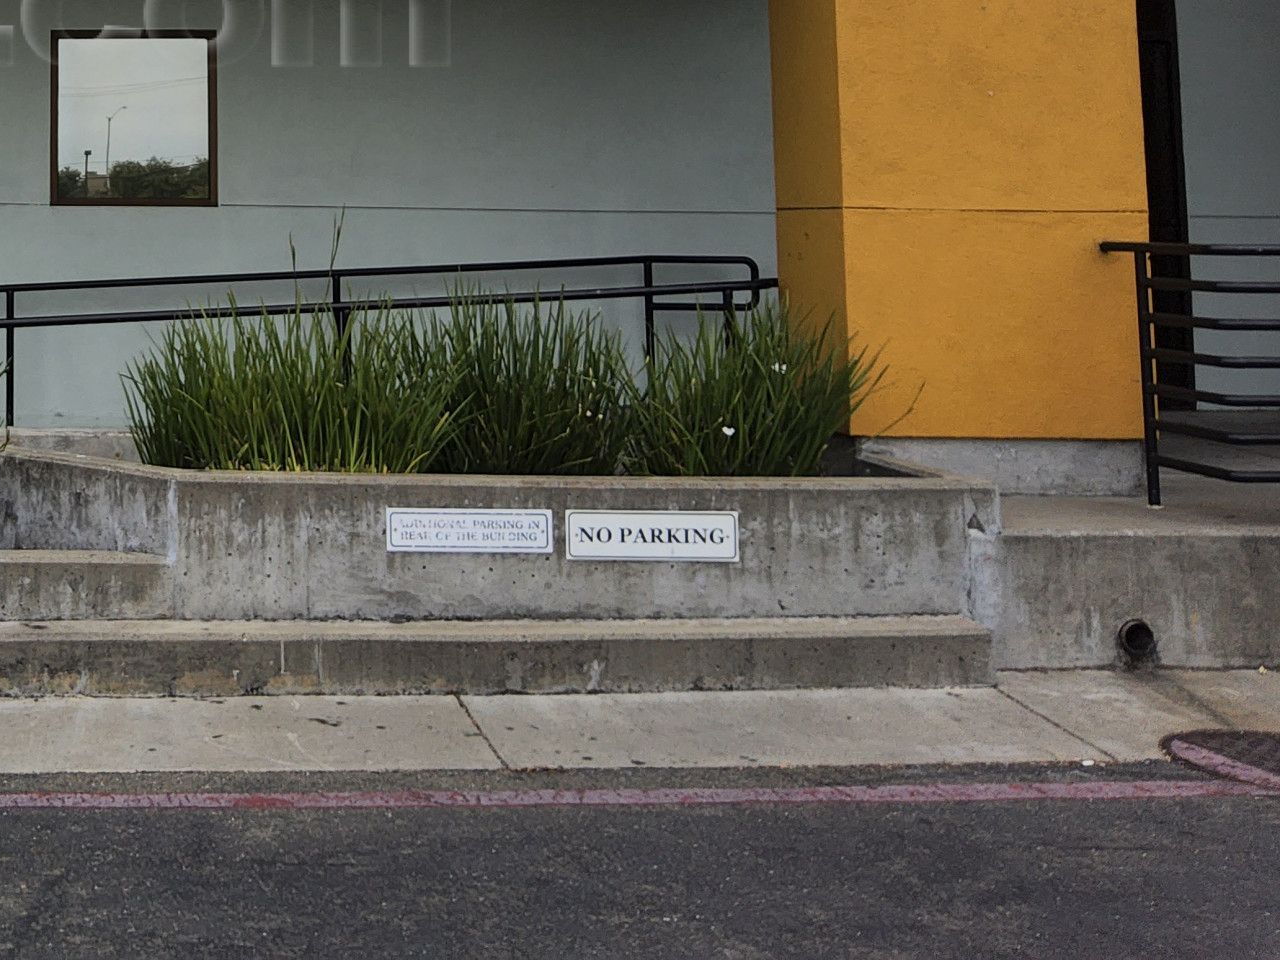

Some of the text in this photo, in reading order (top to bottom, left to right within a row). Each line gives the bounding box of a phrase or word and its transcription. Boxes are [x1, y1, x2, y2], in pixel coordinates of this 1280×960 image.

[473, 519, 523, 529] PARKING
[528, 520, 540, 529] IN
[456, 531, 478, 541] THE
[578, 526, 725, 545] NO PARKING
